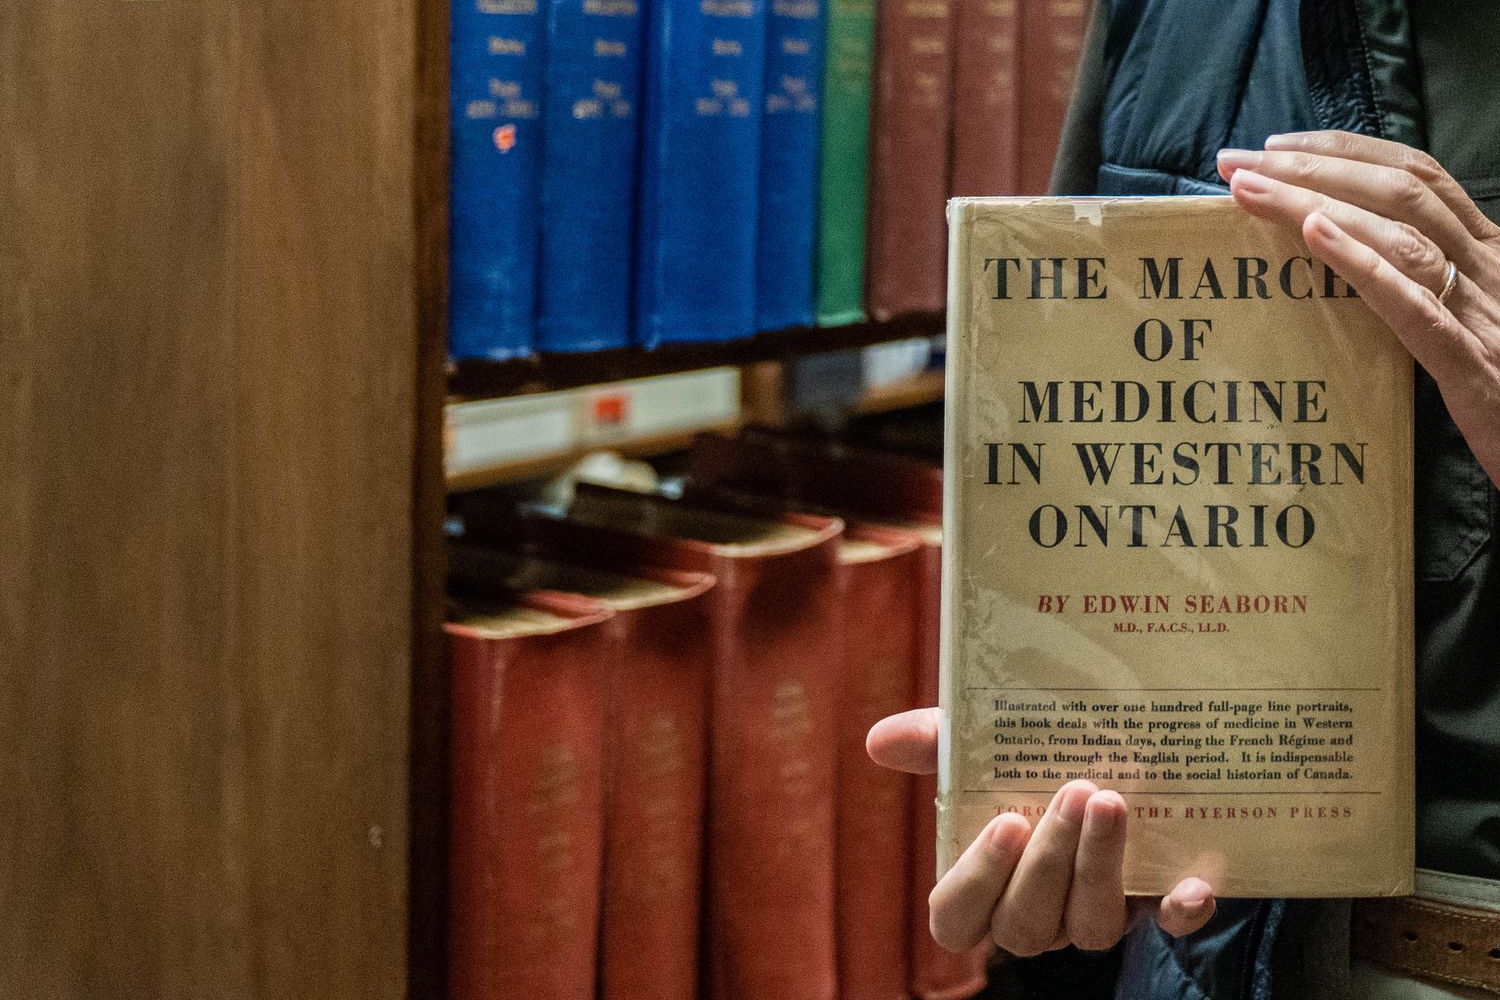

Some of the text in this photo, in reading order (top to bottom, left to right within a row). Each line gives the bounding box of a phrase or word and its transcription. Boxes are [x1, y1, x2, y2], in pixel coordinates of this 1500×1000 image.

[983, 257, 1109, 301] THE
[1133, 318, 1213, 363] OF
[1018, 380, 1329, 425] MEDICINE
[983, 441, 1369, 487] IN WESTERN
[1028, 503, 1317, 550] ONTARIO
[1037, 594, 1309, 614] BY EDWIN SEABORN
[994, 699, 1354, 715] Illustrated with over one hundred full-page line portraits,
[994, 717, 1353, 733] this book deals with the progress of medicine in Western
[993, 733, 1354, 750] Ontario, from Indian days, during the French Régime and
[993, 751, 1354, 767] on down through the English period. It is indispensable
[993, 767, 1353, 780] both to the medical and to the social historian of Canada.
[993, 804, 1354, 820] TORO THE RYERSON PRESS
